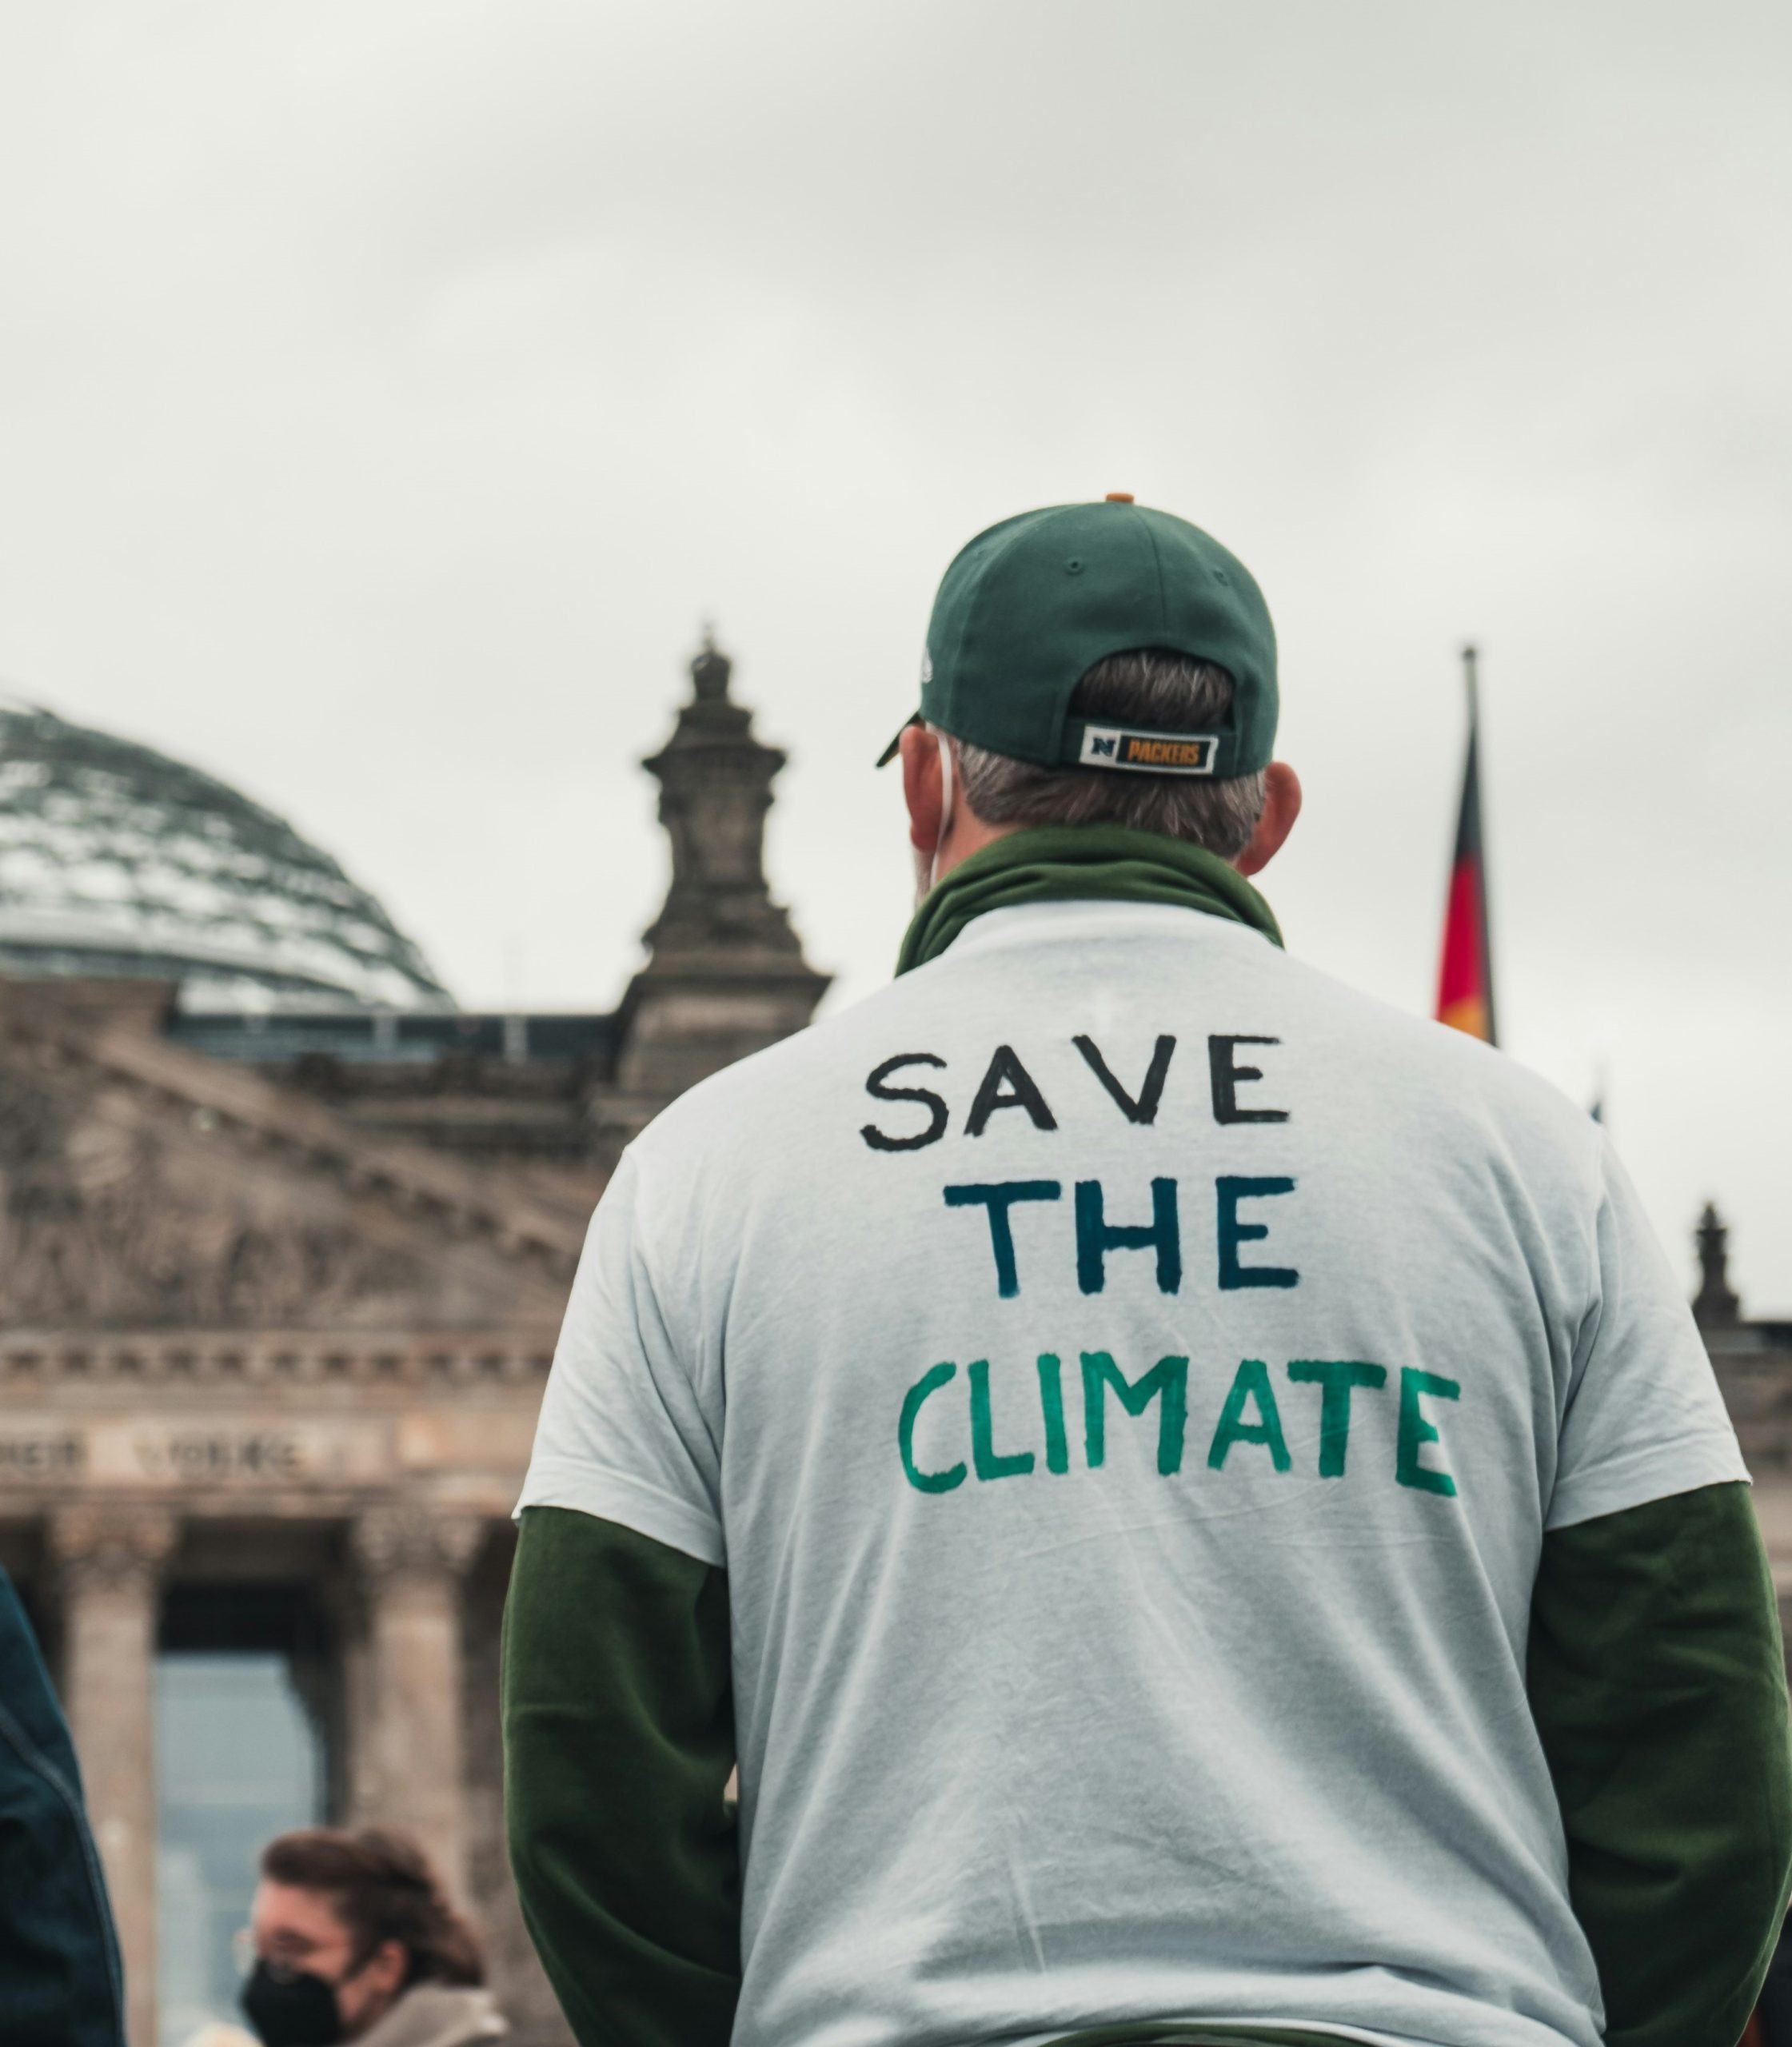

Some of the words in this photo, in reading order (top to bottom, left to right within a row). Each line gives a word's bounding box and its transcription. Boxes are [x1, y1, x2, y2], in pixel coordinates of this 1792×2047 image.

[1128, 740, 1200, 764] PACKERS
[860, 1035, 1289, 1151] SAVE
[944, 1175, 1299, 1298] THE
[899, 1351, 1461, 1497] CLIMATE
